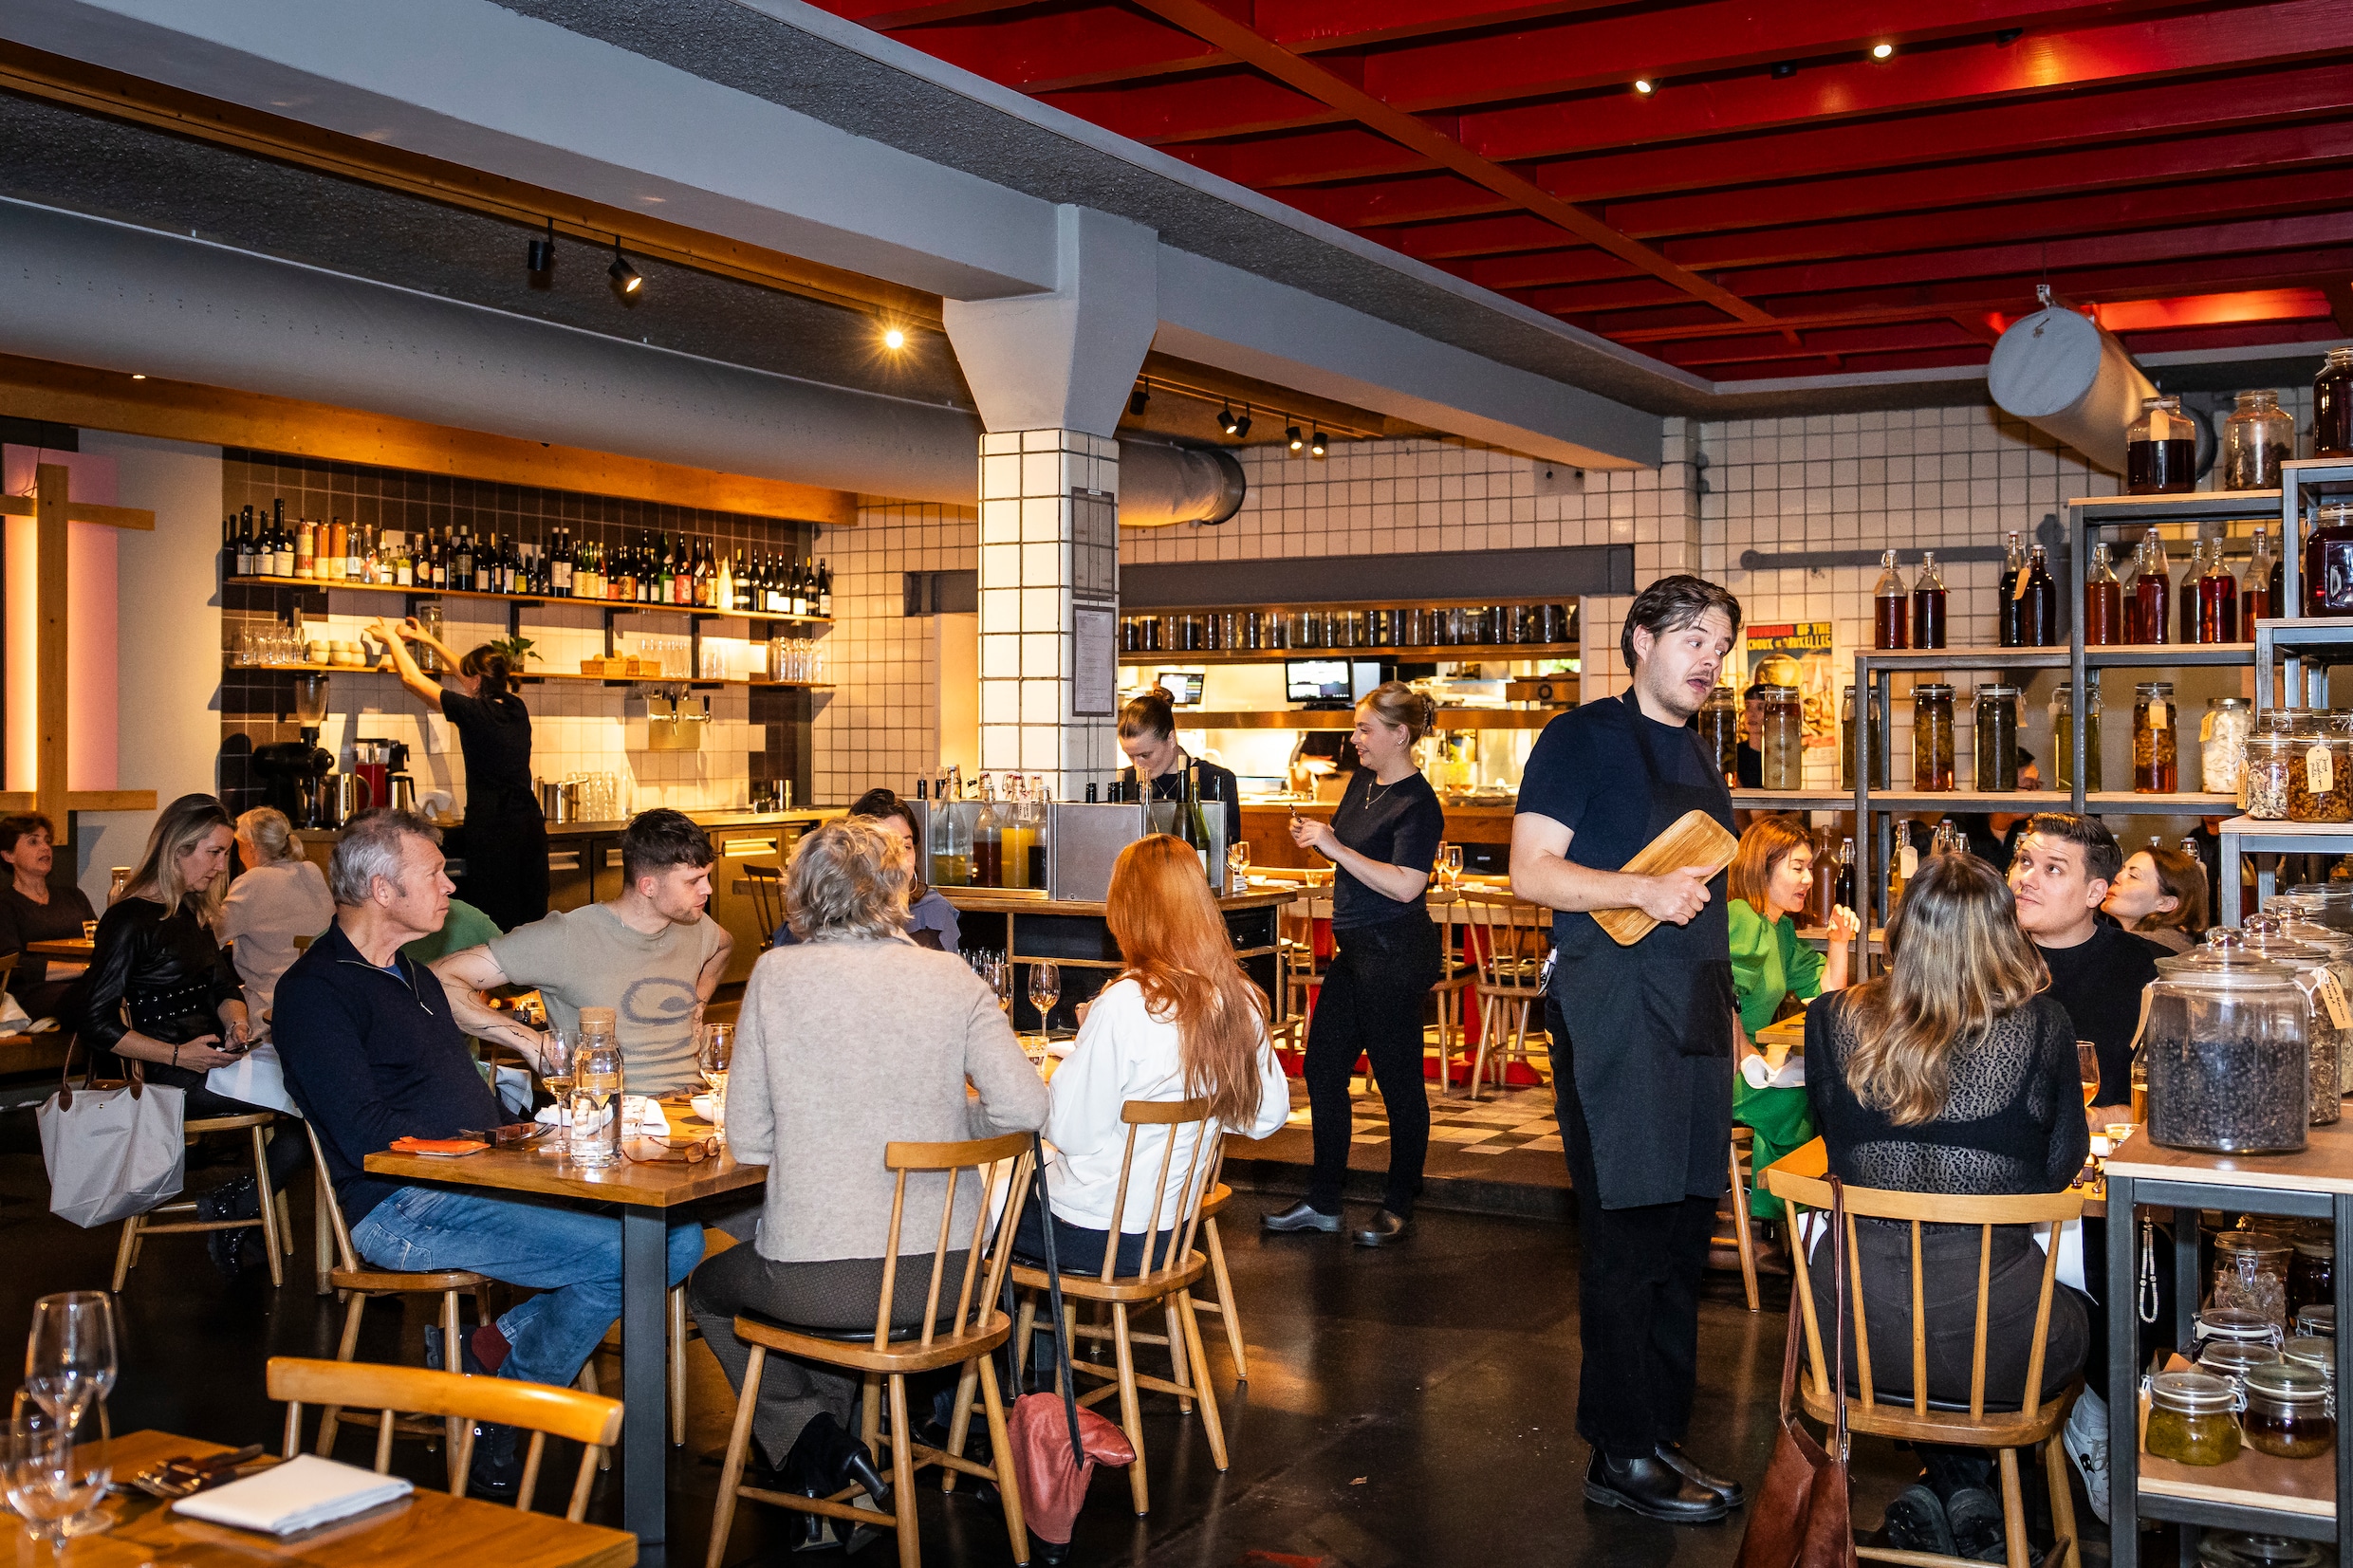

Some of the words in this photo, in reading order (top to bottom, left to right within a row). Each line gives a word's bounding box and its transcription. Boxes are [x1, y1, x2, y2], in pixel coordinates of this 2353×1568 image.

[1797, 623, 1809, 636] OF
[1812, 622, 1831, 635] THE
[1747, 638, 1773, 651] CHOUX
